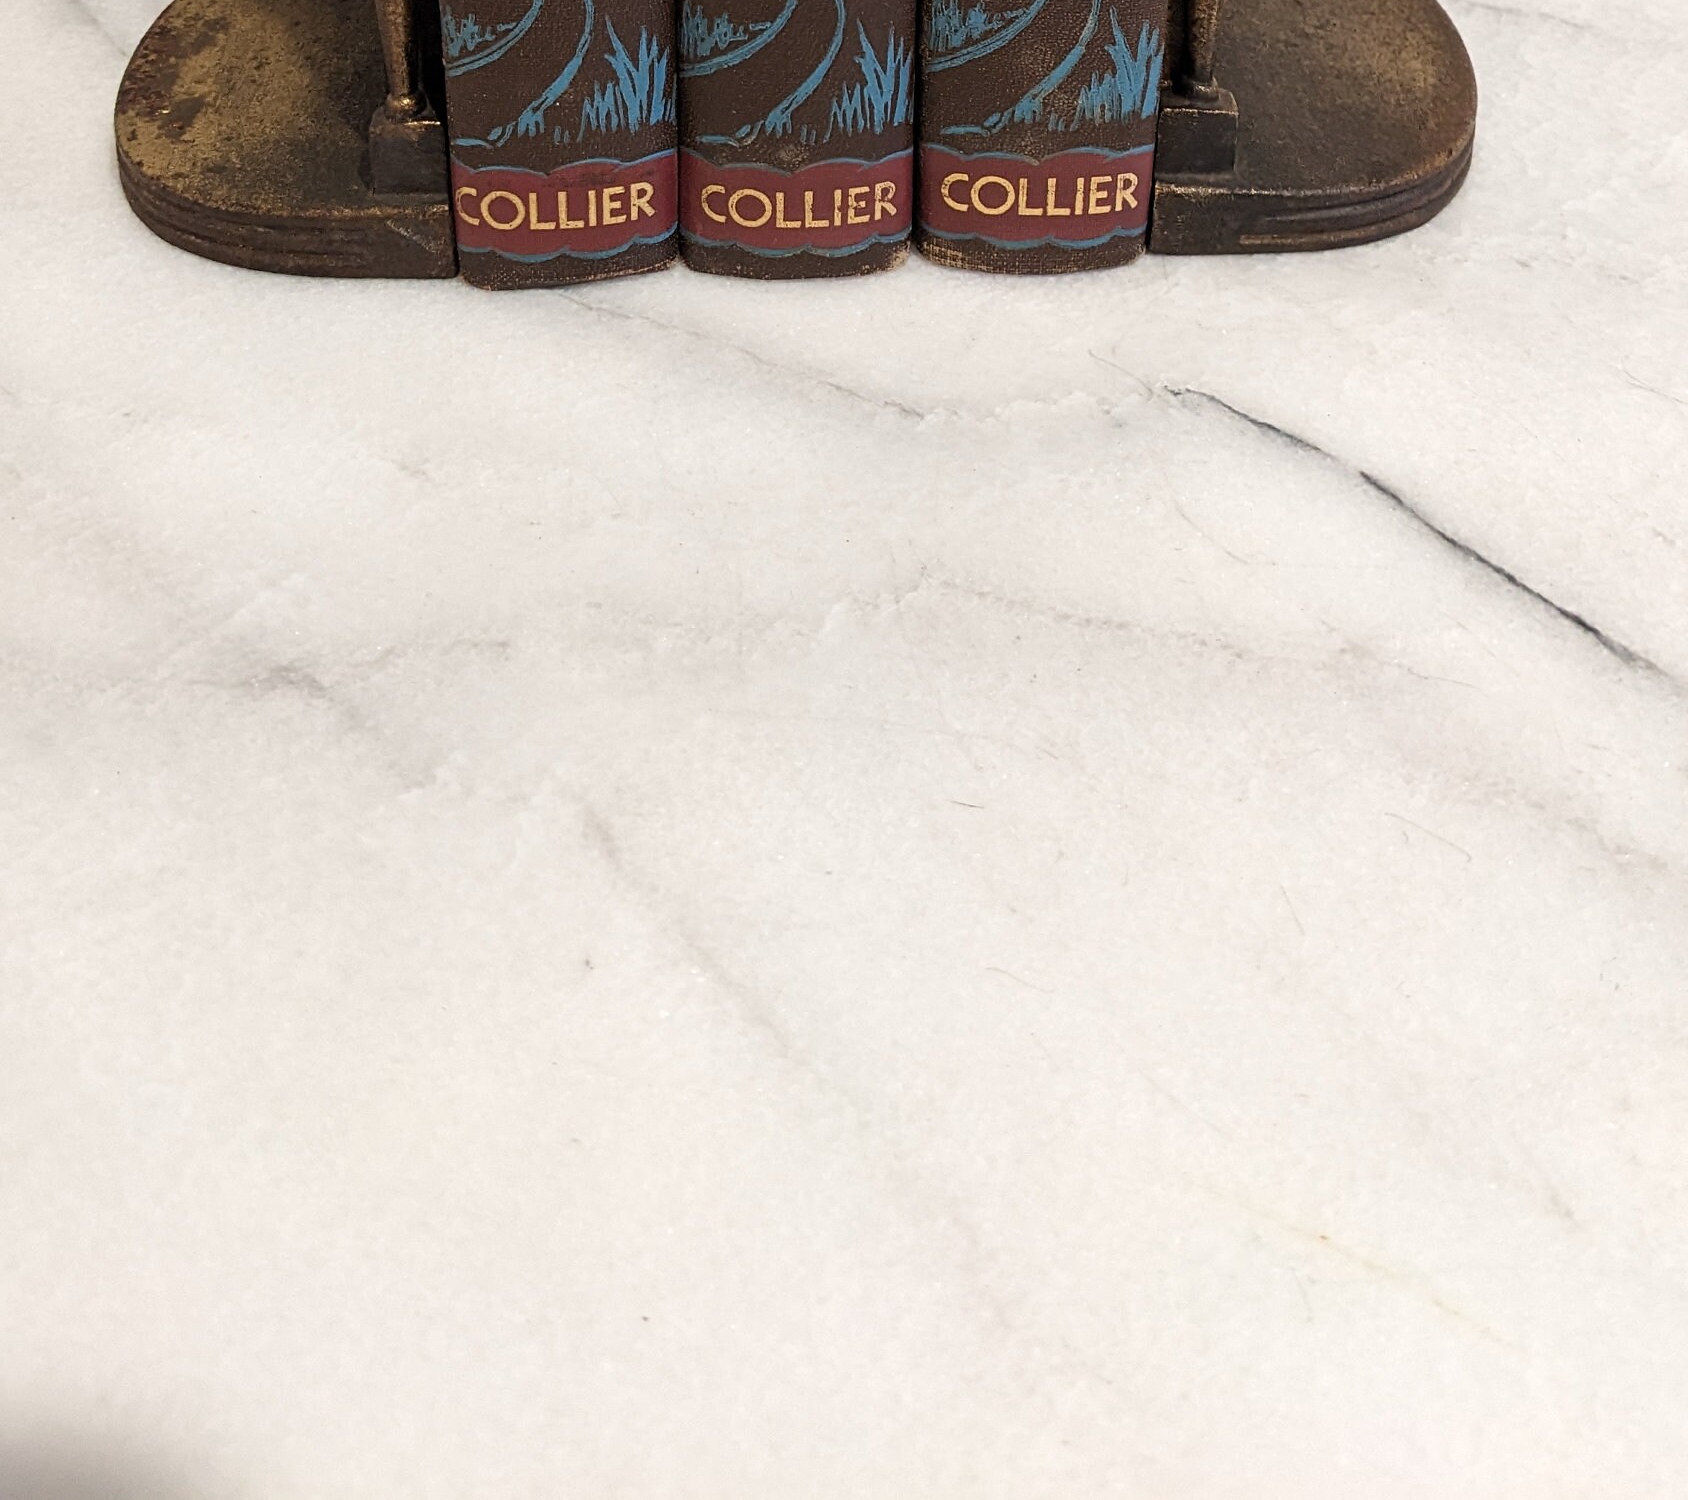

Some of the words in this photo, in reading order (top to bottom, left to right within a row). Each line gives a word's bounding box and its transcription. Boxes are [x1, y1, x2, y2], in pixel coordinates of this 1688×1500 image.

[456, 182, 655, 230] COLLIER
[702, 182, 896, 228] COLLIER
[941, 173, 1138, 216] COLLIER
